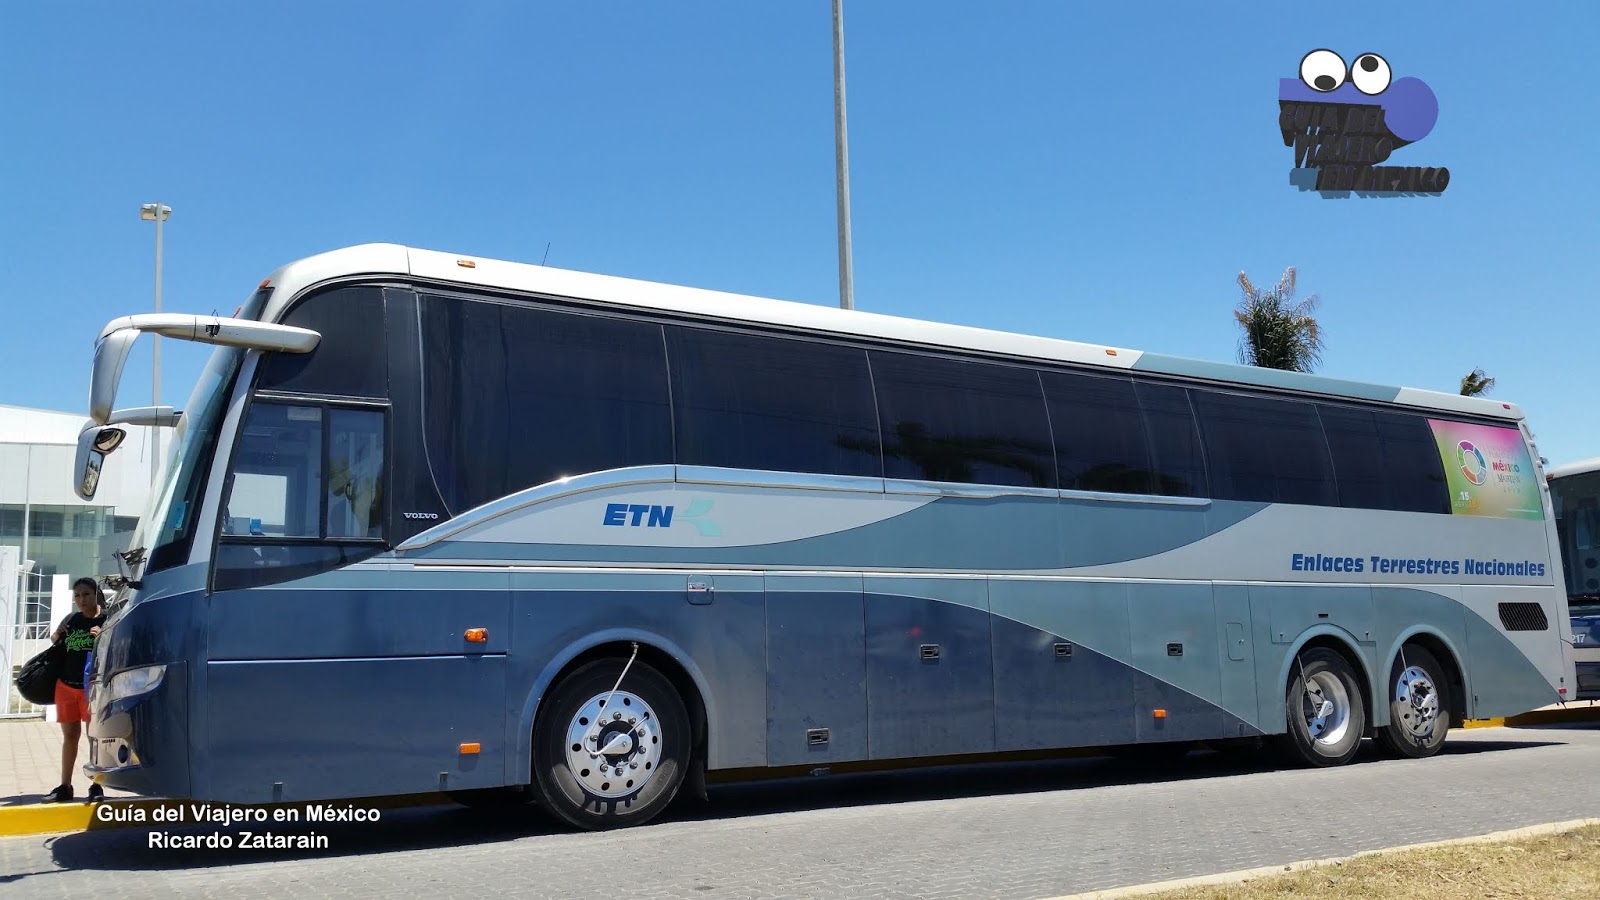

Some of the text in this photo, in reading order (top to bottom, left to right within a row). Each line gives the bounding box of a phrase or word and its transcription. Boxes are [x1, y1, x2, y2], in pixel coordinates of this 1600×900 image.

[403, 512, 438, 520] VOLVO
[602, 503, 674, 527] ETN
[1292, 553, 1545, 577] Enlaces Terrestres Nacionales
